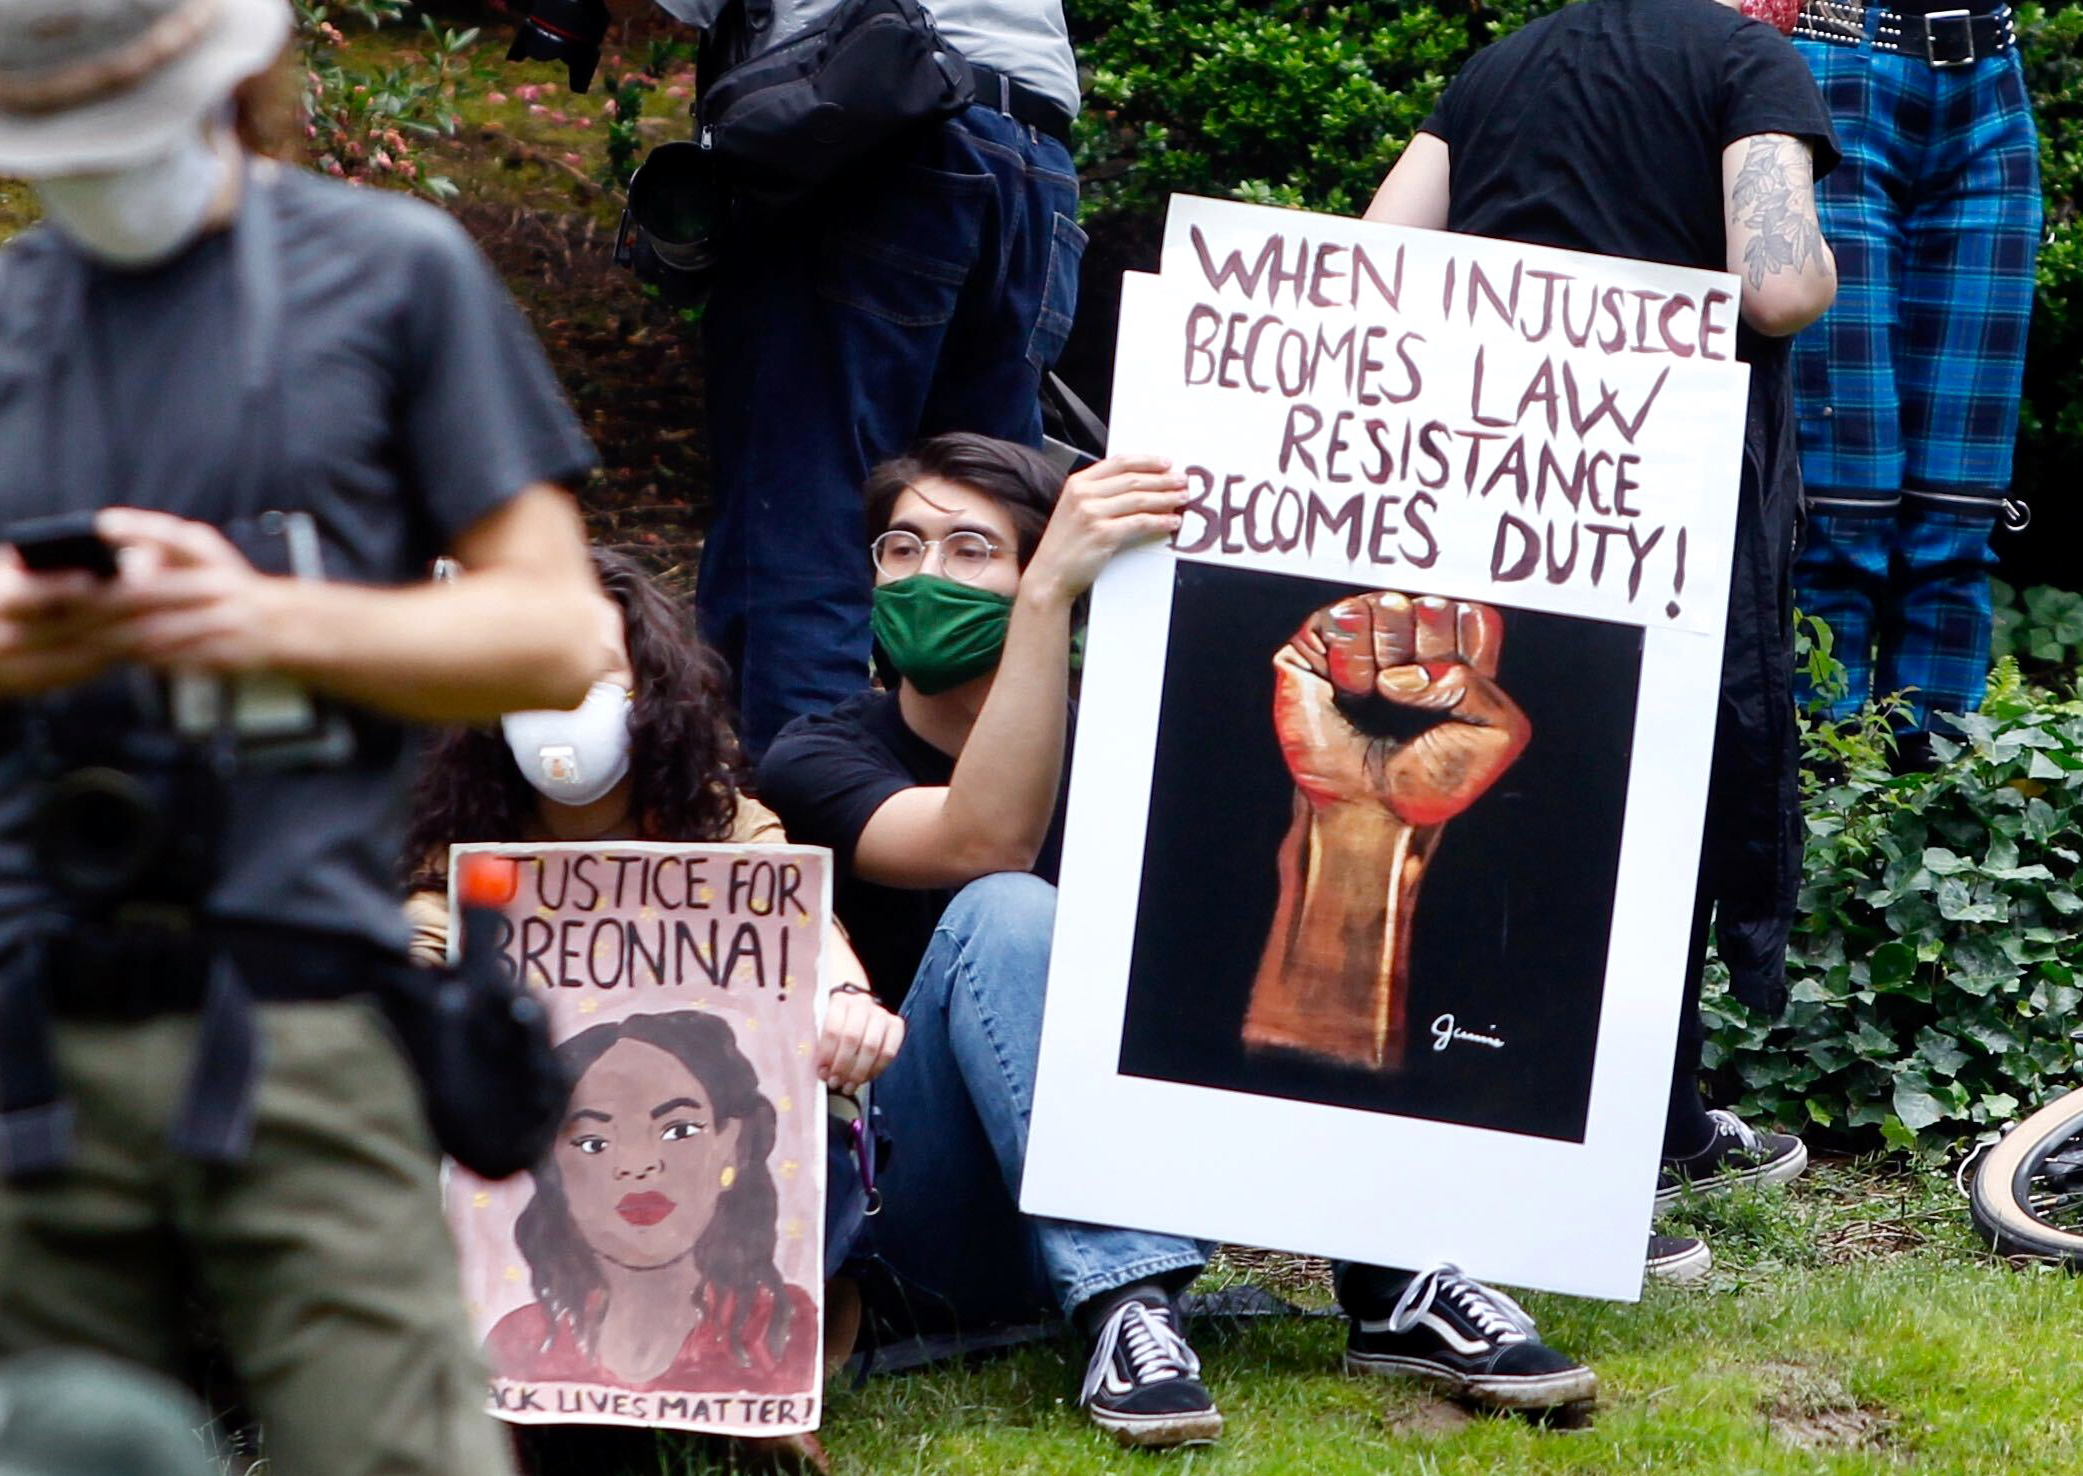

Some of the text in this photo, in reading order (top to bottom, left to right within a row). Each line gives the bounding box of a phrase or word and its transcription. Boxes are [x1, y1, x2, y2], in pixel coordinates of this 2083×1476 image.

[1191, 223, 1734, 362] WHEN INJUSTICE
[1184, 302, 1671, 444] BECOMES LAW
[1278, 403, 1641, 518] RESISTANCE
[1166, 465, 1688, 621] BECOMES DUTY!
[494, 854, 808, 917] JUSTICE FOR
[557, 1387, 648, 1418] LIVES
[657, 1397, 815, 1427] MATTER!
